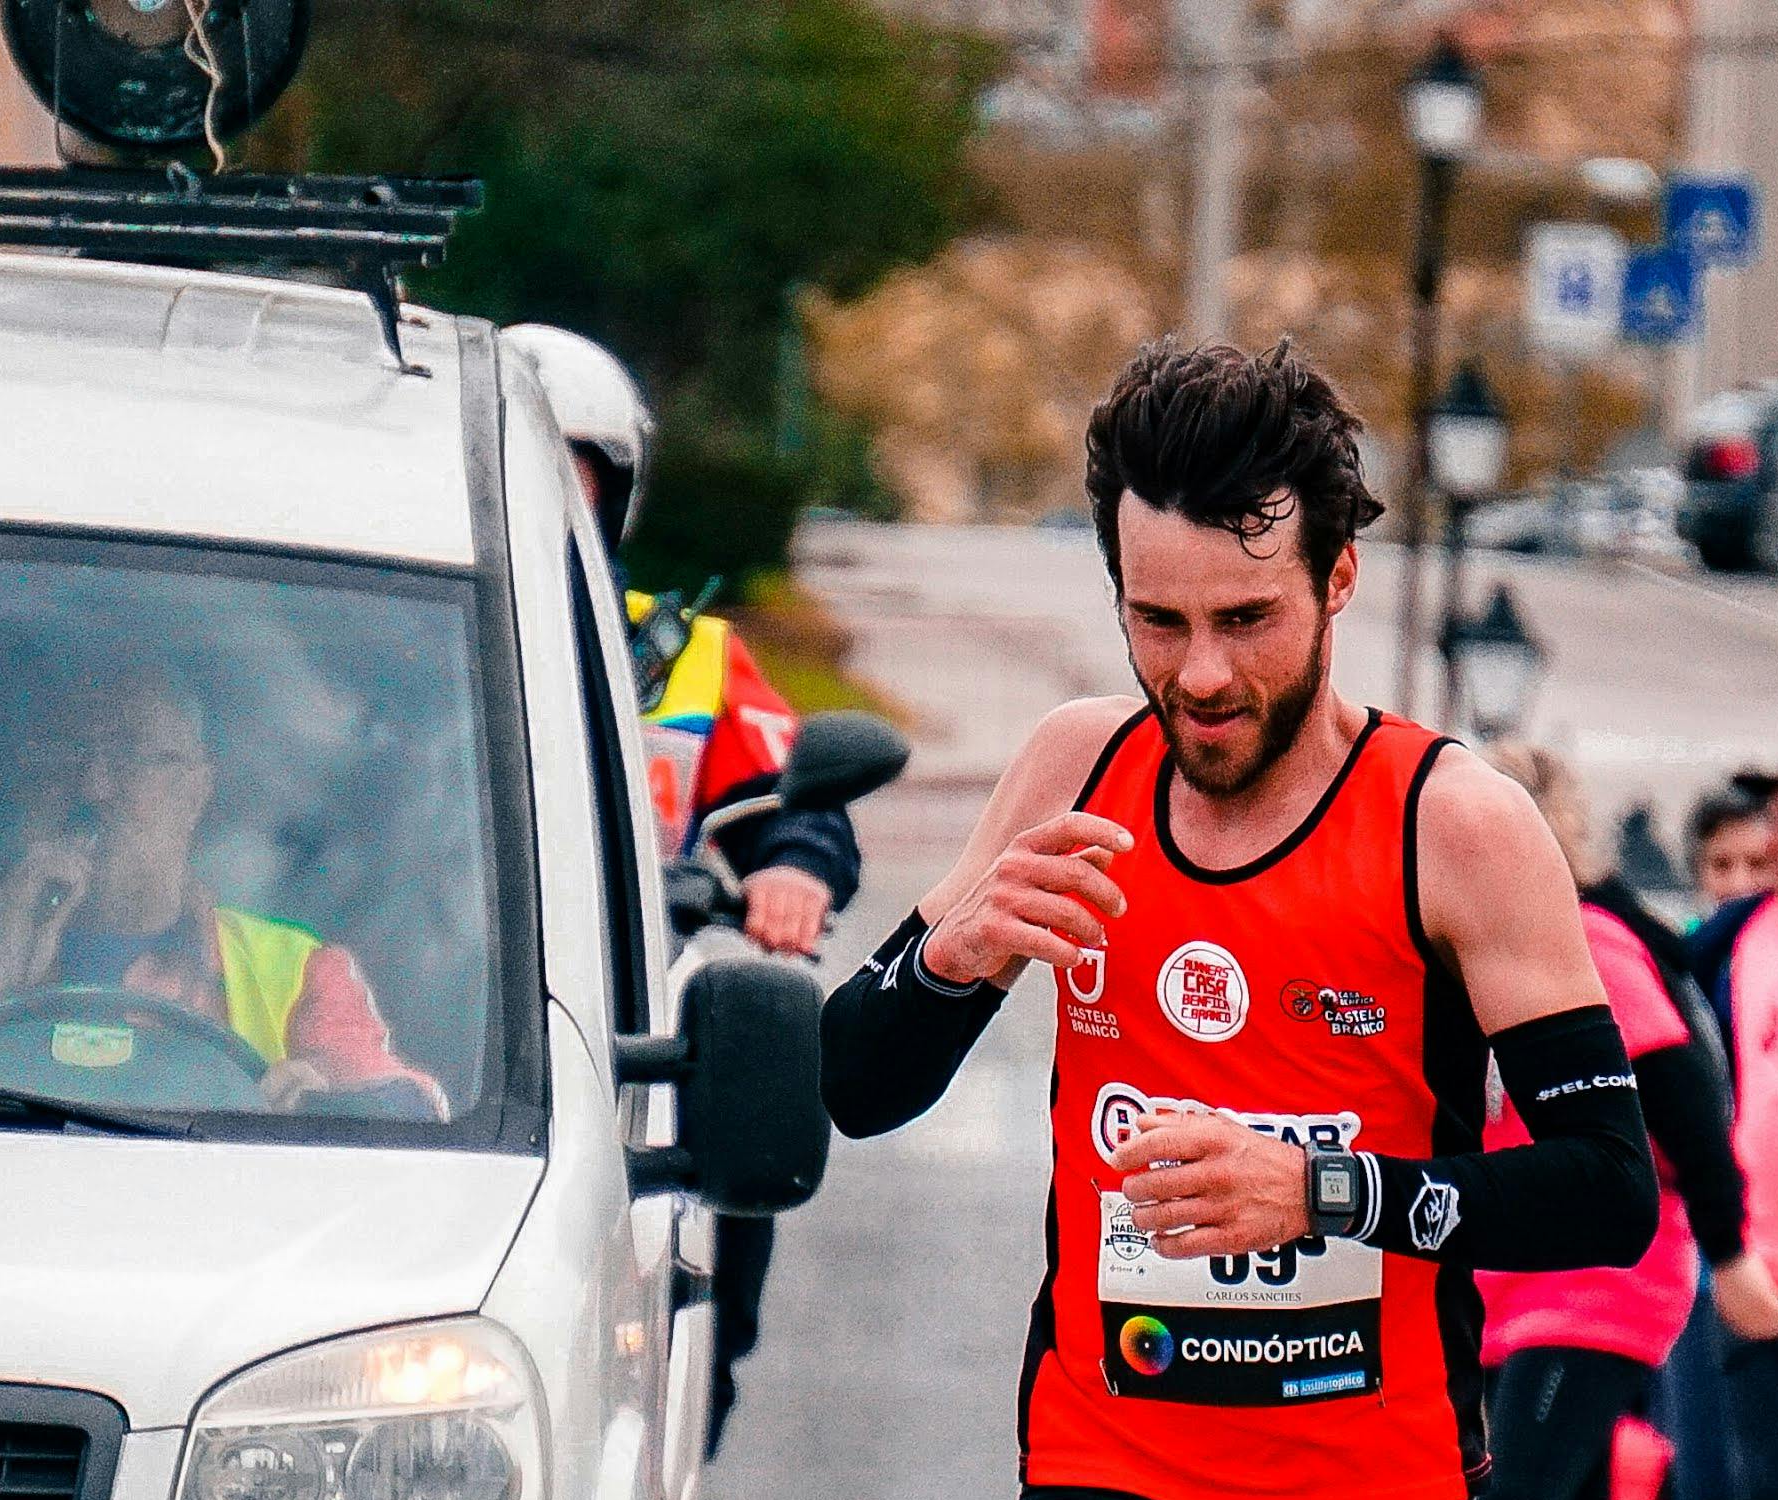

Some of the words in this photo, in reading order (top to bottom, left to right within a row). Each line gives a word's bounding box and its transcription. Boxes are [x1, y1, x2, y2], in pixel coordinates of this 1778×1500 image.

[1183, 972, 1228, 999] CASA
[1182, 994, 1230, 1011] BENFICA
[1066, 1003, 1118, 1026] CASTELO
[1324, 1007, 1385, 1023] CASTELO
[1071, 1018, 1120, 1039] BRANCO
[1332, 1020, 1385, 1036] BRANCO
[1205, 1291, 1249, 1302] CARLOS
[1251, 1292, 1302, 1302] SANCHES
[1180, 1330, 1365, 1364] CONDÓPTICA
